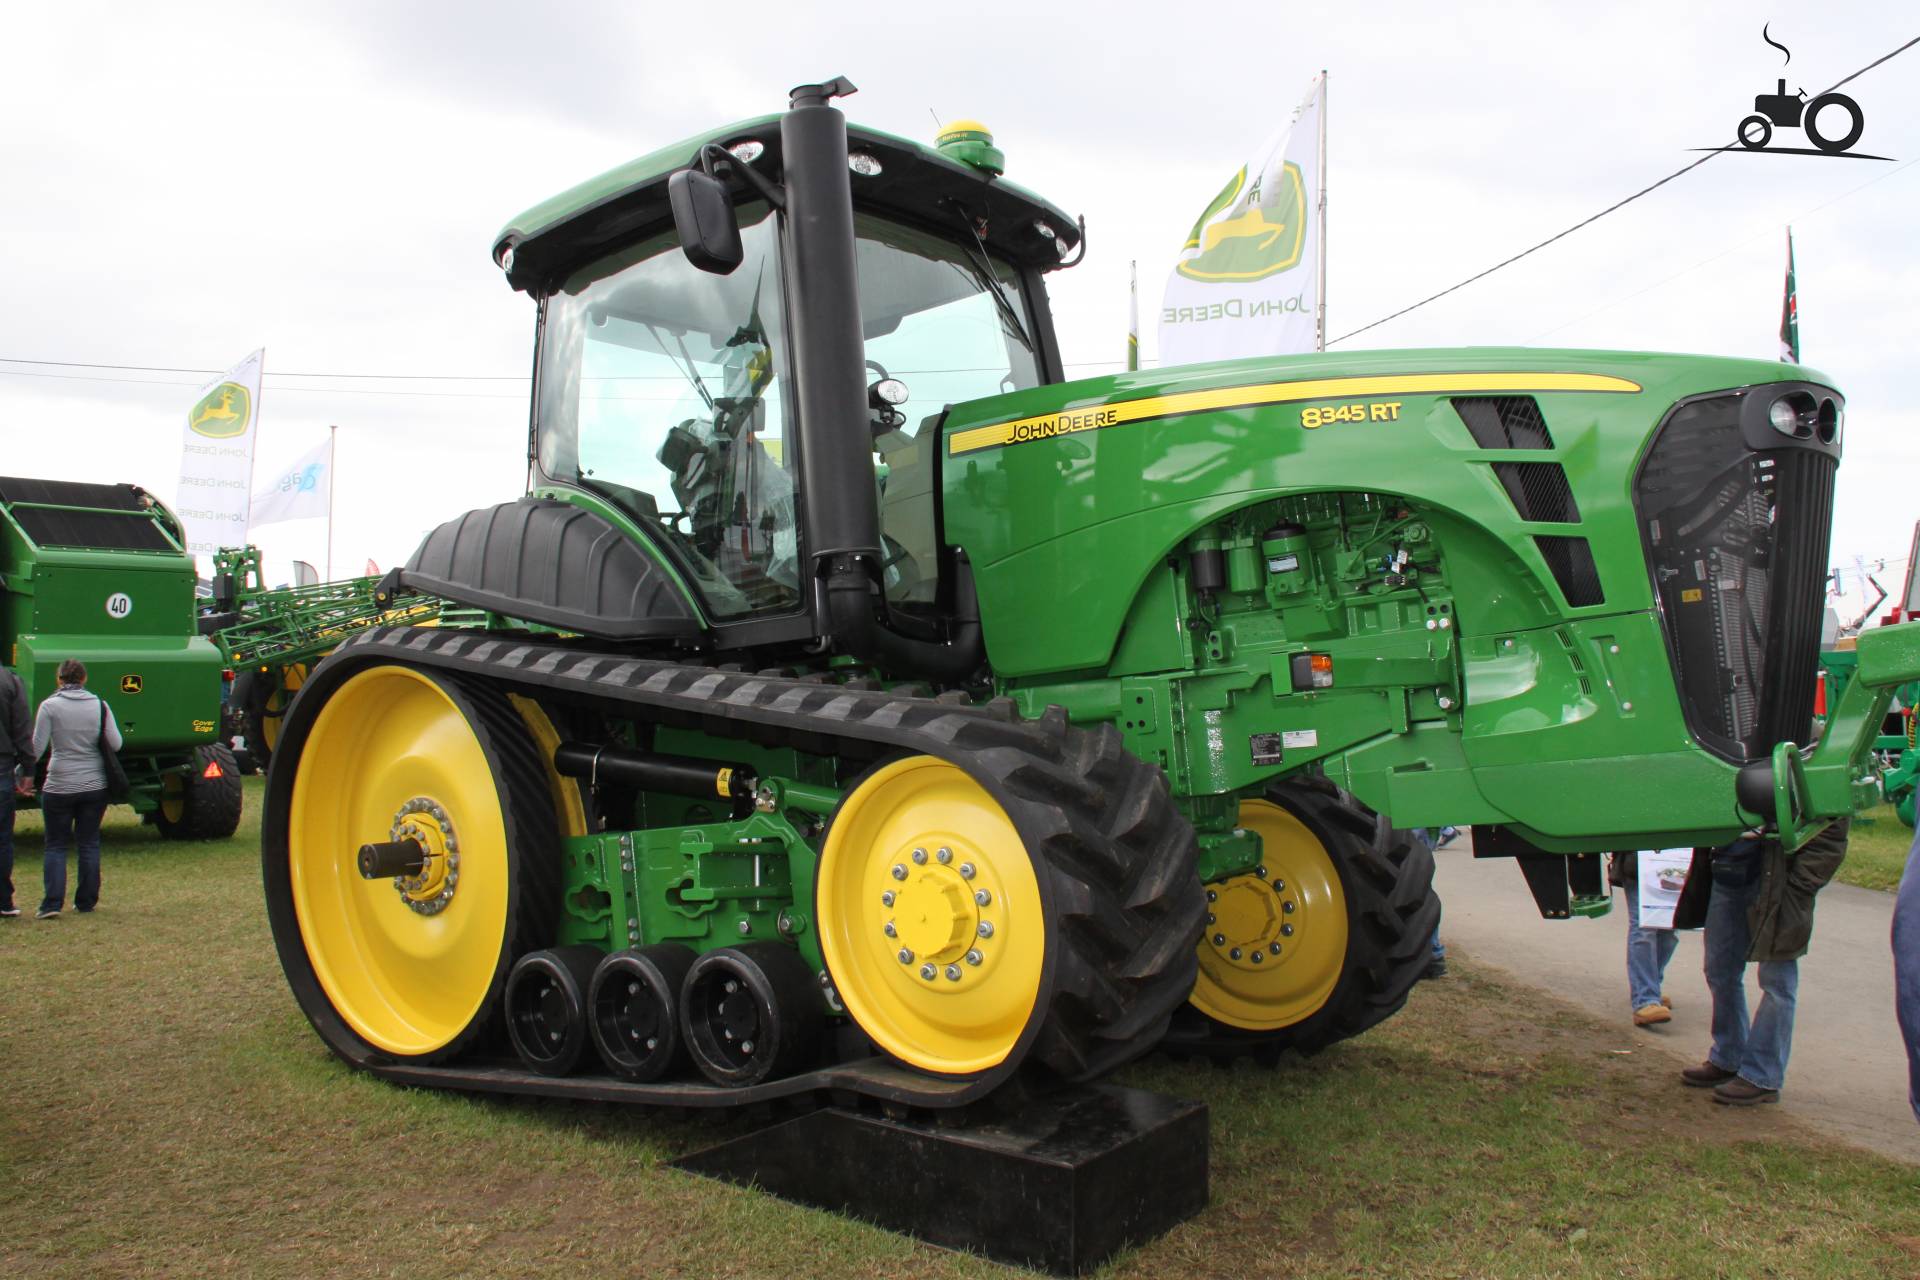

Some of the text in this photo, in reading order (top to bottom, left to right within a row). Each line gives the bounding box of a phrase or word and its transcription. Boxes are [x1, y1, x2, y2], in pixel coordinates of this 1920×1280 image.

[1007, 409, 1118, 441] JOHN DEERE
[1301, 402, 1402, 428] 8345 RT
[111, 597, 127, 613] 40
[193, 725, 214, 733] Edge
